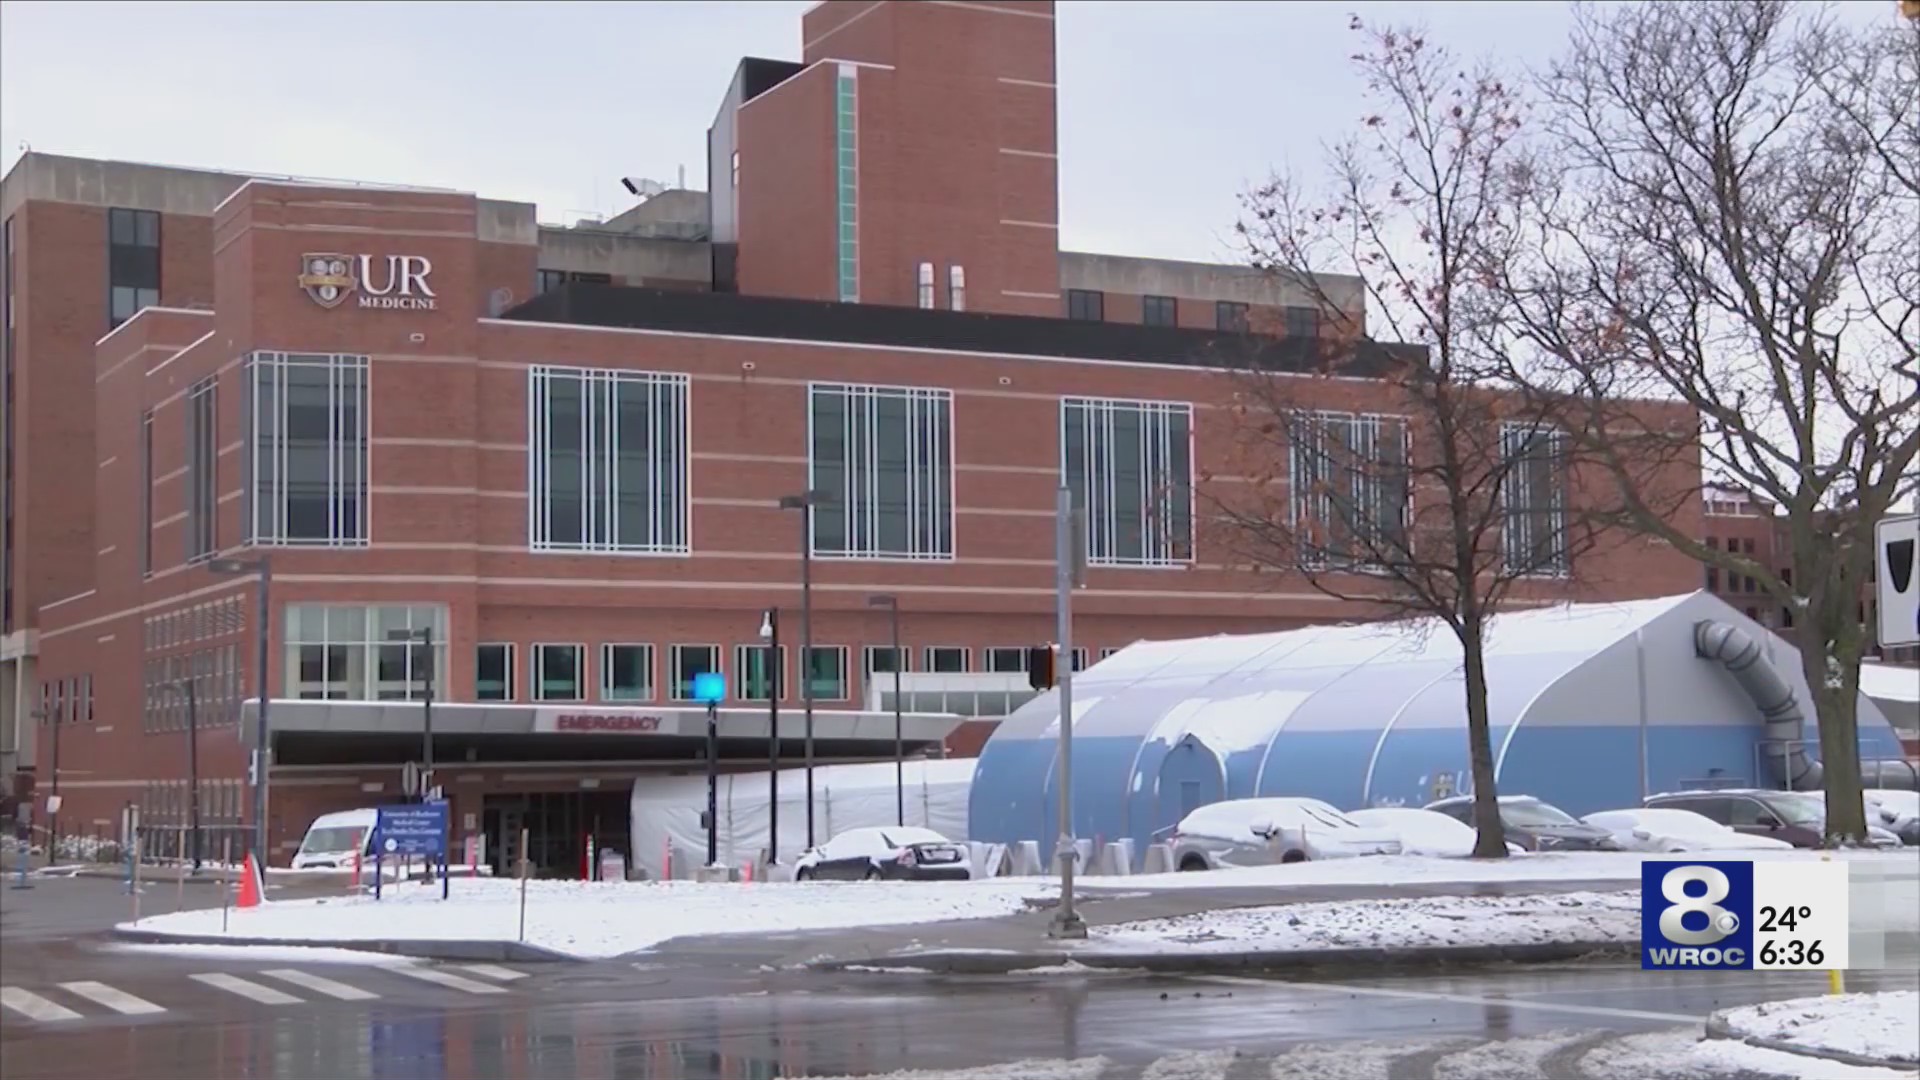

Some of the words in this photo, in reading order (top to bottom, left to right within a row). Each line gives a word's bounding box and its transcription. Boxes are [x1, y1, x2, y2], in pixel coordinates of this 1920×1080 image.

[359, 255, 436, 296] UR
[358, 297, 438, 310] MEDICINE
[556, 714, 662, 731] EMERGENCY
